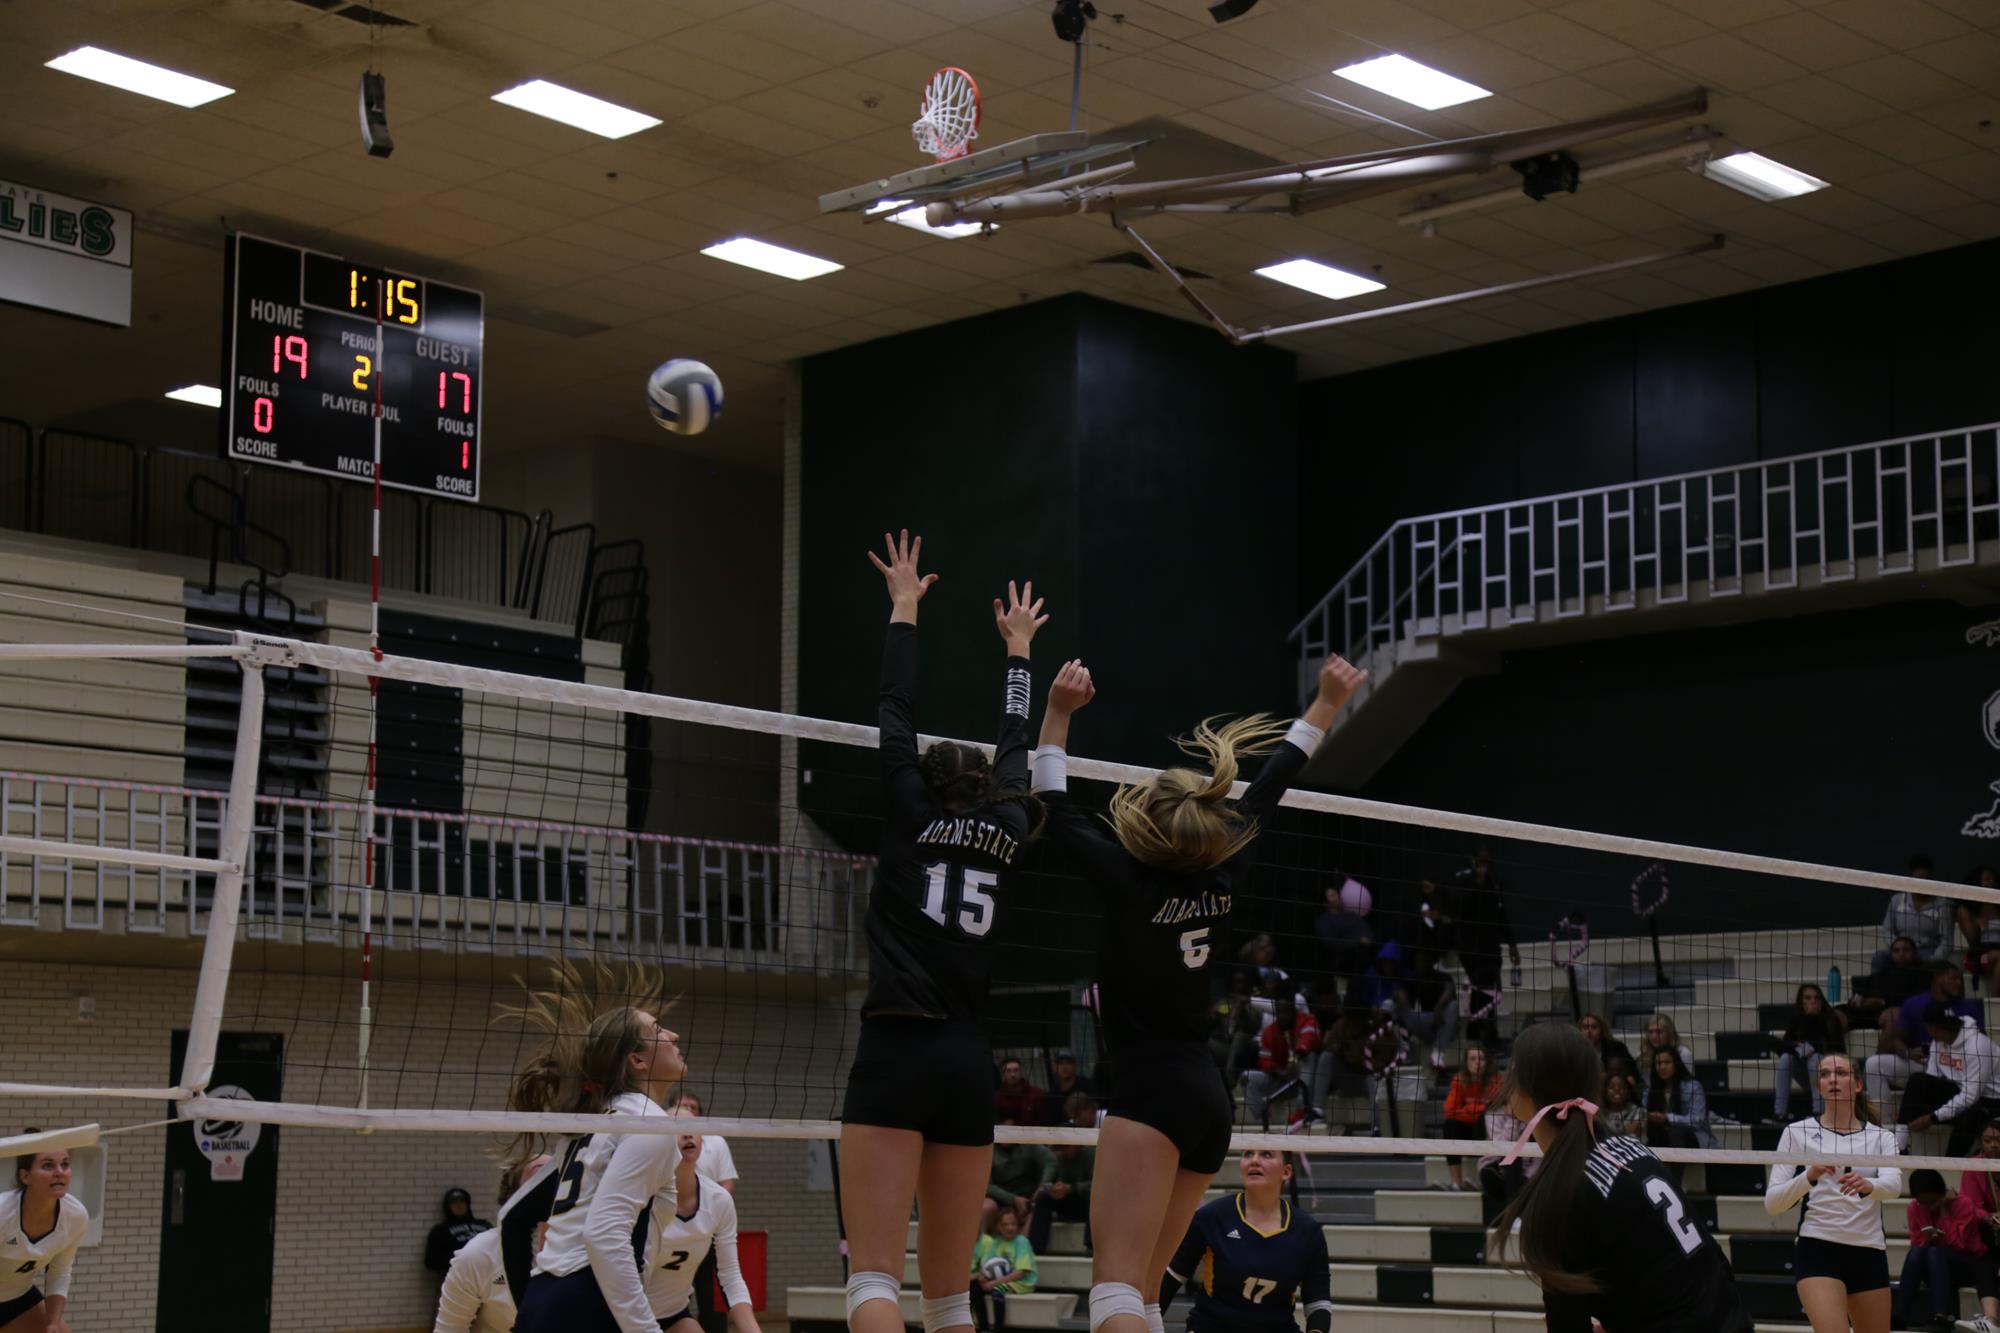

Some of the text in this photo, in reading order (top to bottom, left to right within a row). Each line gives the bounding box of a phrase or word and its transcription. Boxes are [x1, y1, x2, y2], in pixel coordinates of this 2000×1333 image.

[350, 270, 419, 324] 1:15
[251, 298, 304, 329] HOME
[341, 331, 383, 352] PERIO
[416, 337, 471, 367] GUEST
[273, 335, 307, 380] 19
[352, 354, 371, 391] 2
[239, 376, 279, 398] FOULS
[439, 371, 471, 413] 17
[253, 397, 273, 433] 0
[321, 393, 367, 416] PLAYER
[438, 416, 474, 437] FOULS
[237, 437, 278, 458] SCORE
[436, 475, 473, 494] SCORE
[917, 818, 1018, 864] ADAMS STATE
[920, 861, 998, 936] 15
[1644, 1176, 1702, 1254] 2
[661, 1250, 689, 1270] 2
[1243, 1276, 1277, 1304] 17
